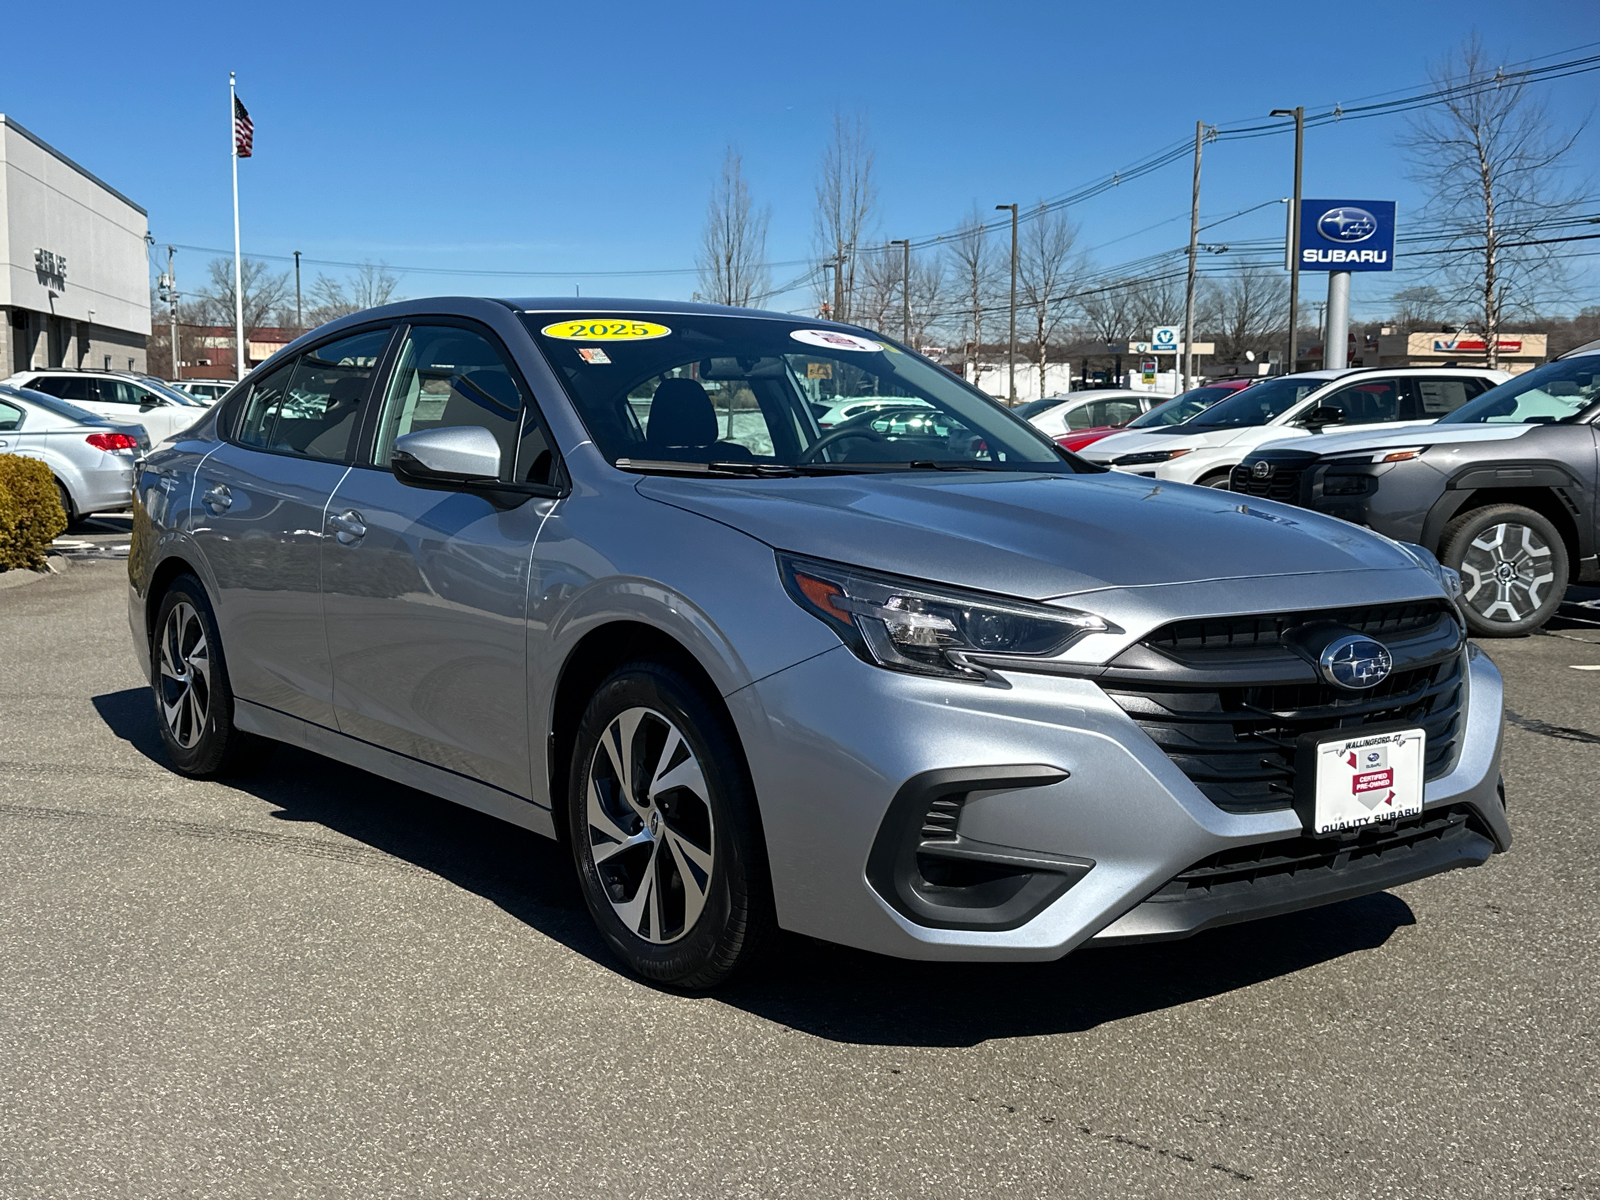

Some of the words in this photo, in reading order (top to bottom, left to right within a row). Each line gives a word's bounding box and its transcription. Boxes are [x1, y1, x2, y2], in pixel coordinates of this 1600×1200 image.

[1303, 249, 1387, 263] SUBARU
[569, 324, 649, 336] 2025
[1359, 773, 1388, 782] CERTIFIED
[1356, 779, 1390, 790] PRE-OWNED
[1322, 816, 1370, 833] QUALITY
[1374, 807, 1419, 821] SUBARU
